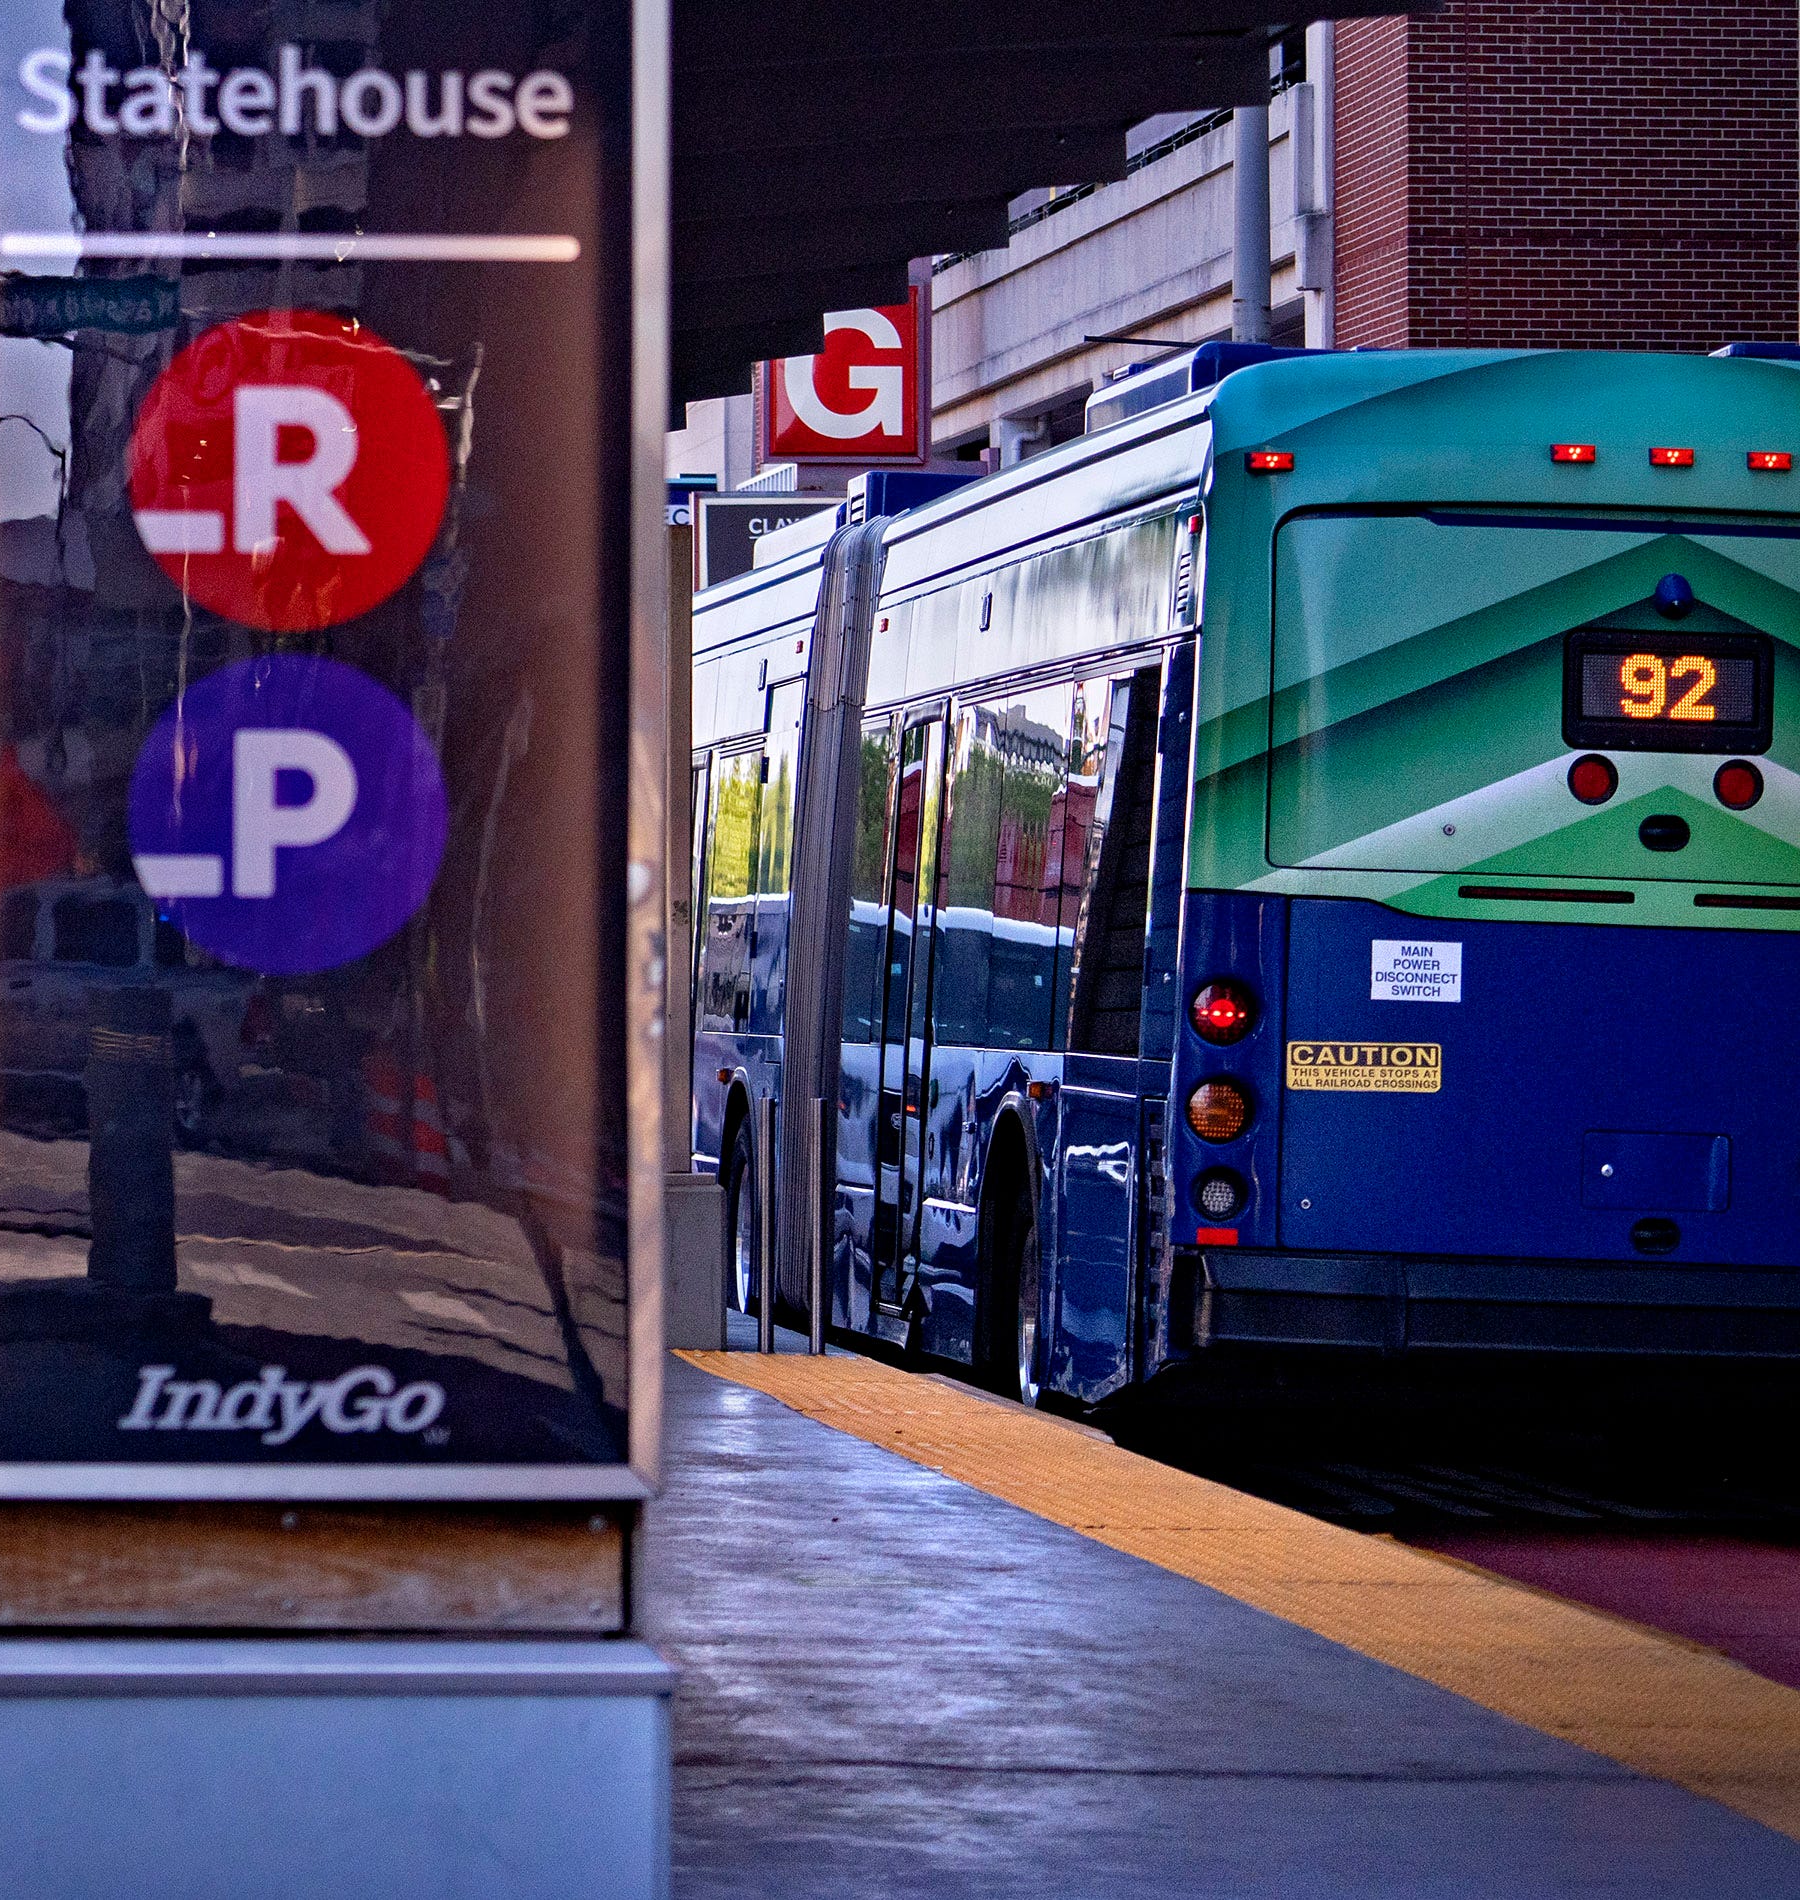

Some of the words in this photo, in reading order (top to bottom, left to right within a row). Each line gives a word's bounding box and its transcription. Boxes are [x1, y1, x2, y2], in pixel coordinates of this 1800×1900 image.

[18, 44, 574, 139] Statehouse
[784, 308, 902, 440] G
[1618, 653, 1717, 722] 92
[233, 728, 358, 899] P
[1401, 945, 1433, 957] MAIN
[1393, 959, 1440, 971] POWER
[1375, 972, 1458, 985] DISCONNECT
[1391, 985, 1441, 997] SWITCH
[1292, 1046, 1437, 1067] CAUTION
[1292, 1068, 1319, 1077] THIS
[1324, 1068, 1375, 1078] VEHICLE
[1380, 1069, 1419, 1078] STOPS
[1423, 1070, 1438, 1079] AT
[1292, 1079, 1312, 1087] ALL
[1315, 1079, 1371, 1088] RAILROAD
[1374, 1080, 1438, 1089] CROSSINGS
[118, 1363, 446, 1446] IndyGo
